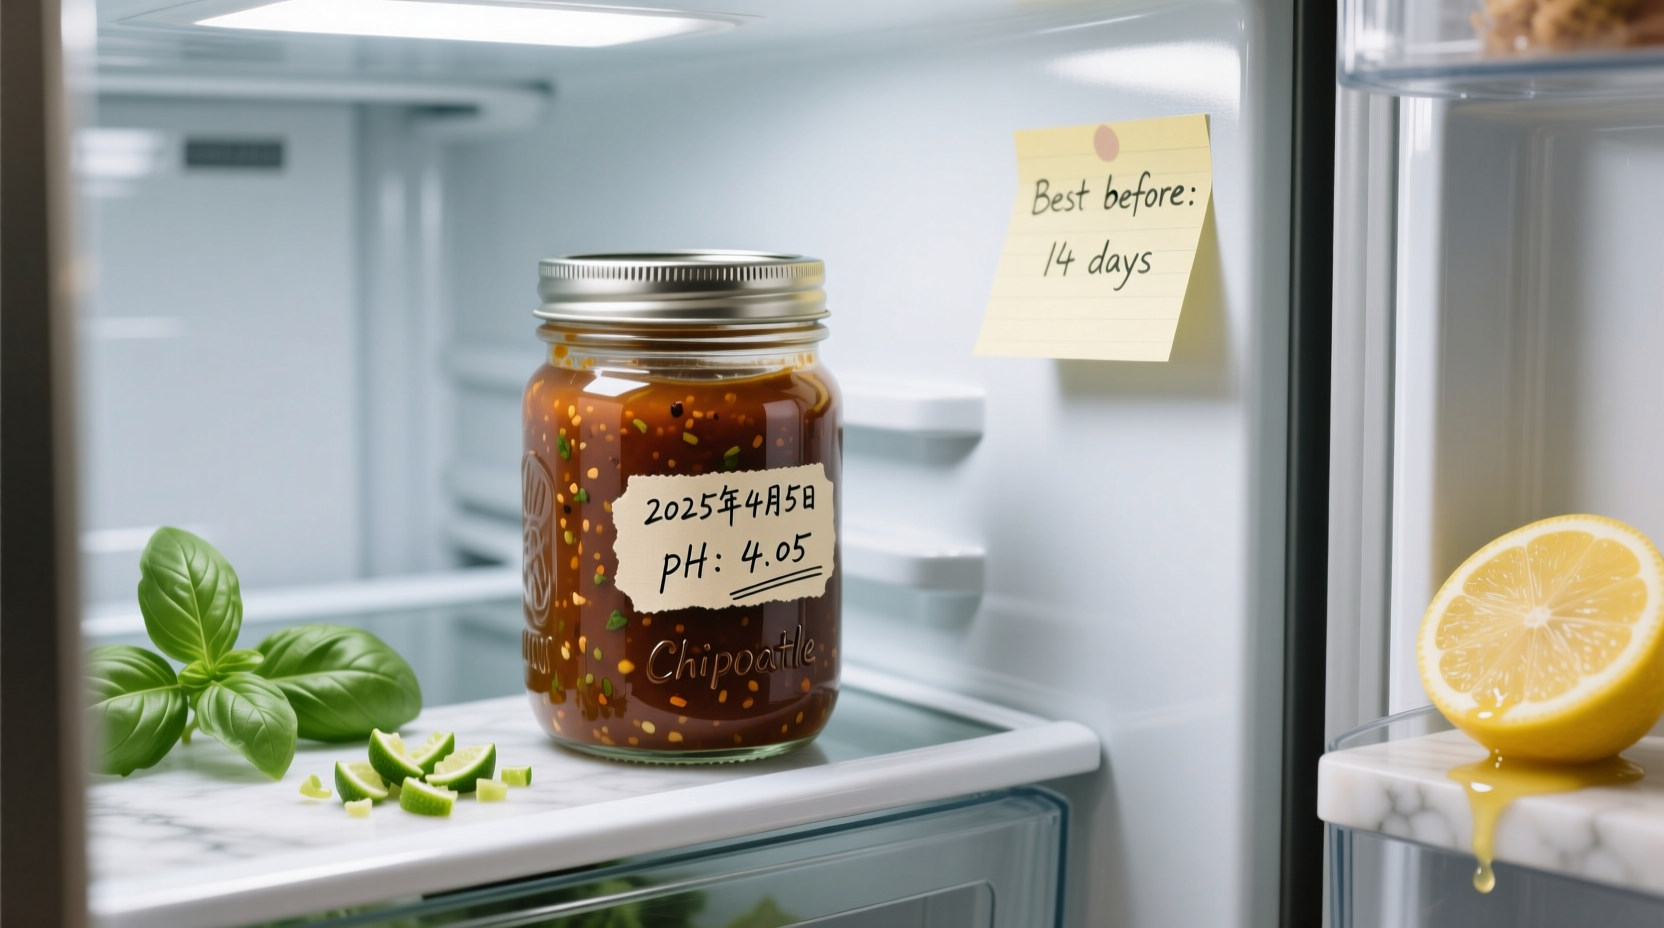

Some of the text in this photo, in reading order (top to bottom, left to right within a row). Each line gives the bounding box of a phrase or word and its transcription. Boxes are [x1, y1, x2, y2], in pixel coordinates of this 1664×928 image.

[1032, 171, 1196, 217] Best before:
[1043, 239, 1153, 291] 14 days
[644, 484, 815, 527] 2025年4月5日
[659, 532, 812, 594] pH: 4.05
[646, 624, 816, 690] Chipoatle
